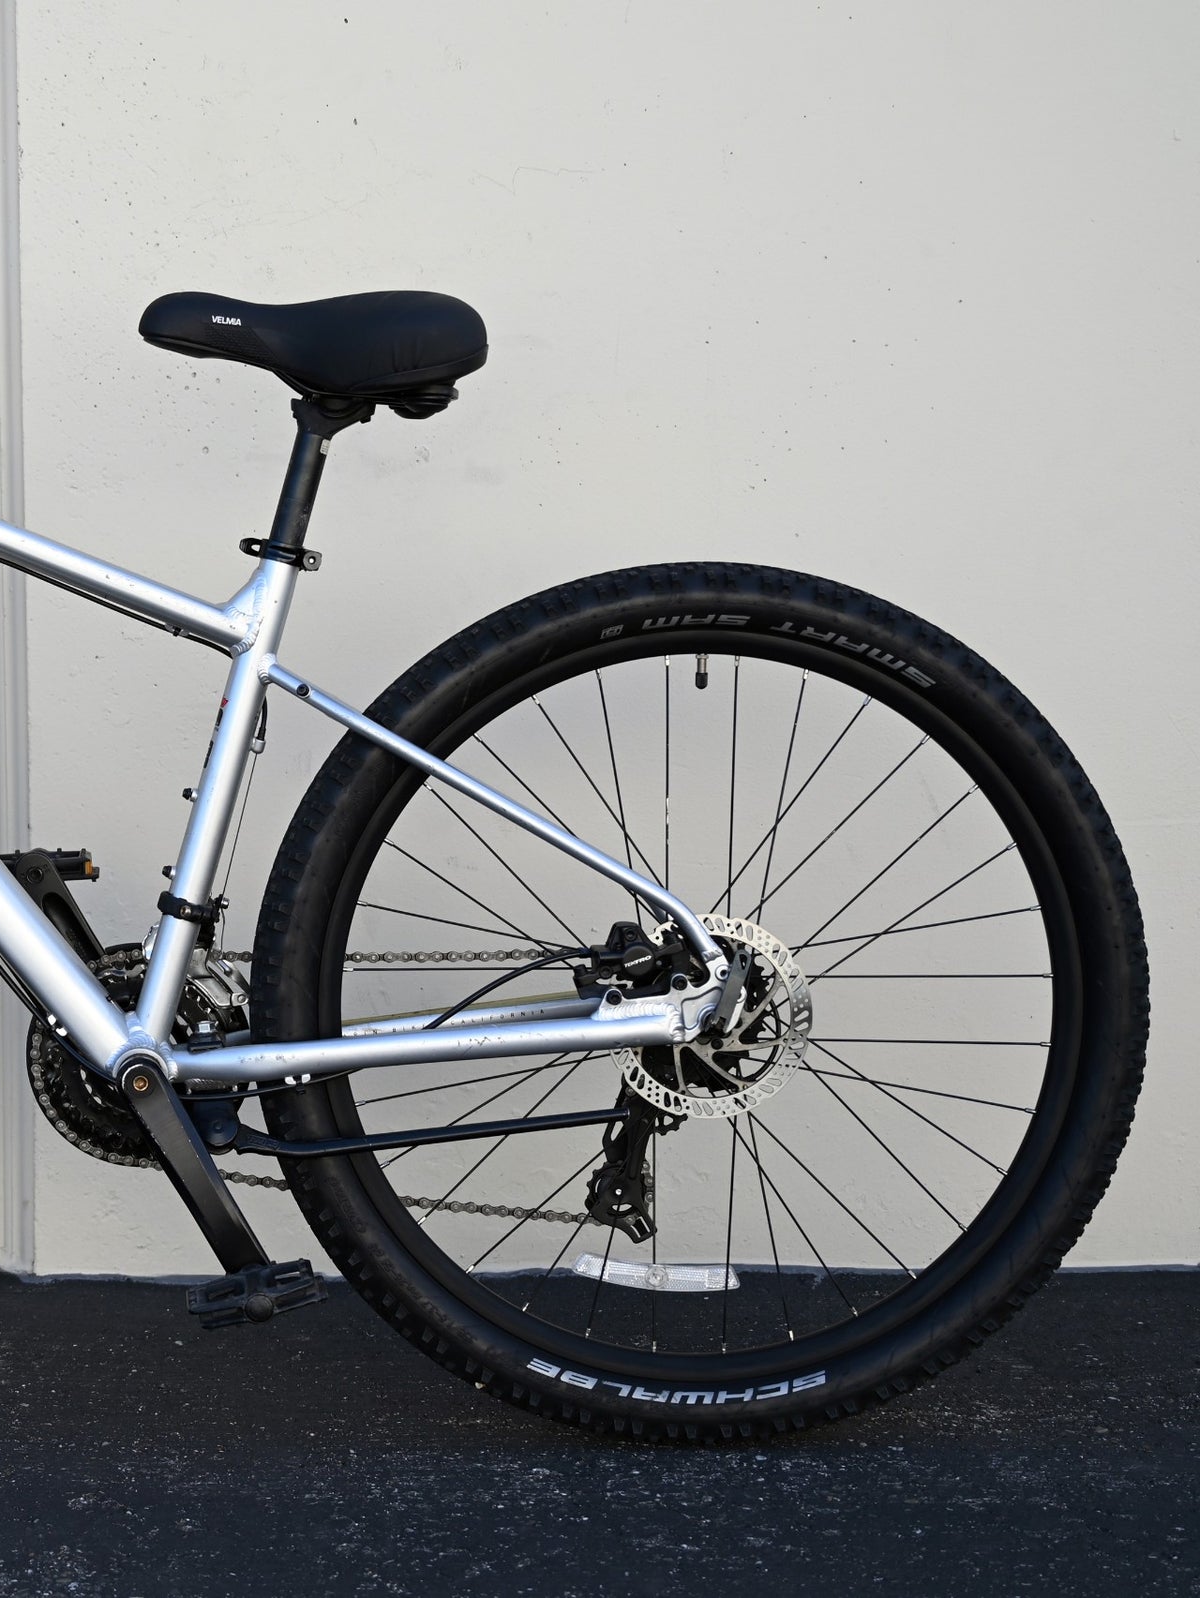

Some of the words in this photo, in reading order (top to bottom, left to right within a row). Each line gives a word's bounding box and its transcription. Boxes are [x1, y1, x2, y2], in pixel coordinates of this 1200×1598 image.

[211, 315, 242, 326] VELMIA
[642, 614, 751, 629] SAM
[771, 620, 937, 688] SMART
[450, 1008, 545, 1026] CALIFORNIA
[526, 1357, 827, 1405] SCHWALBE
